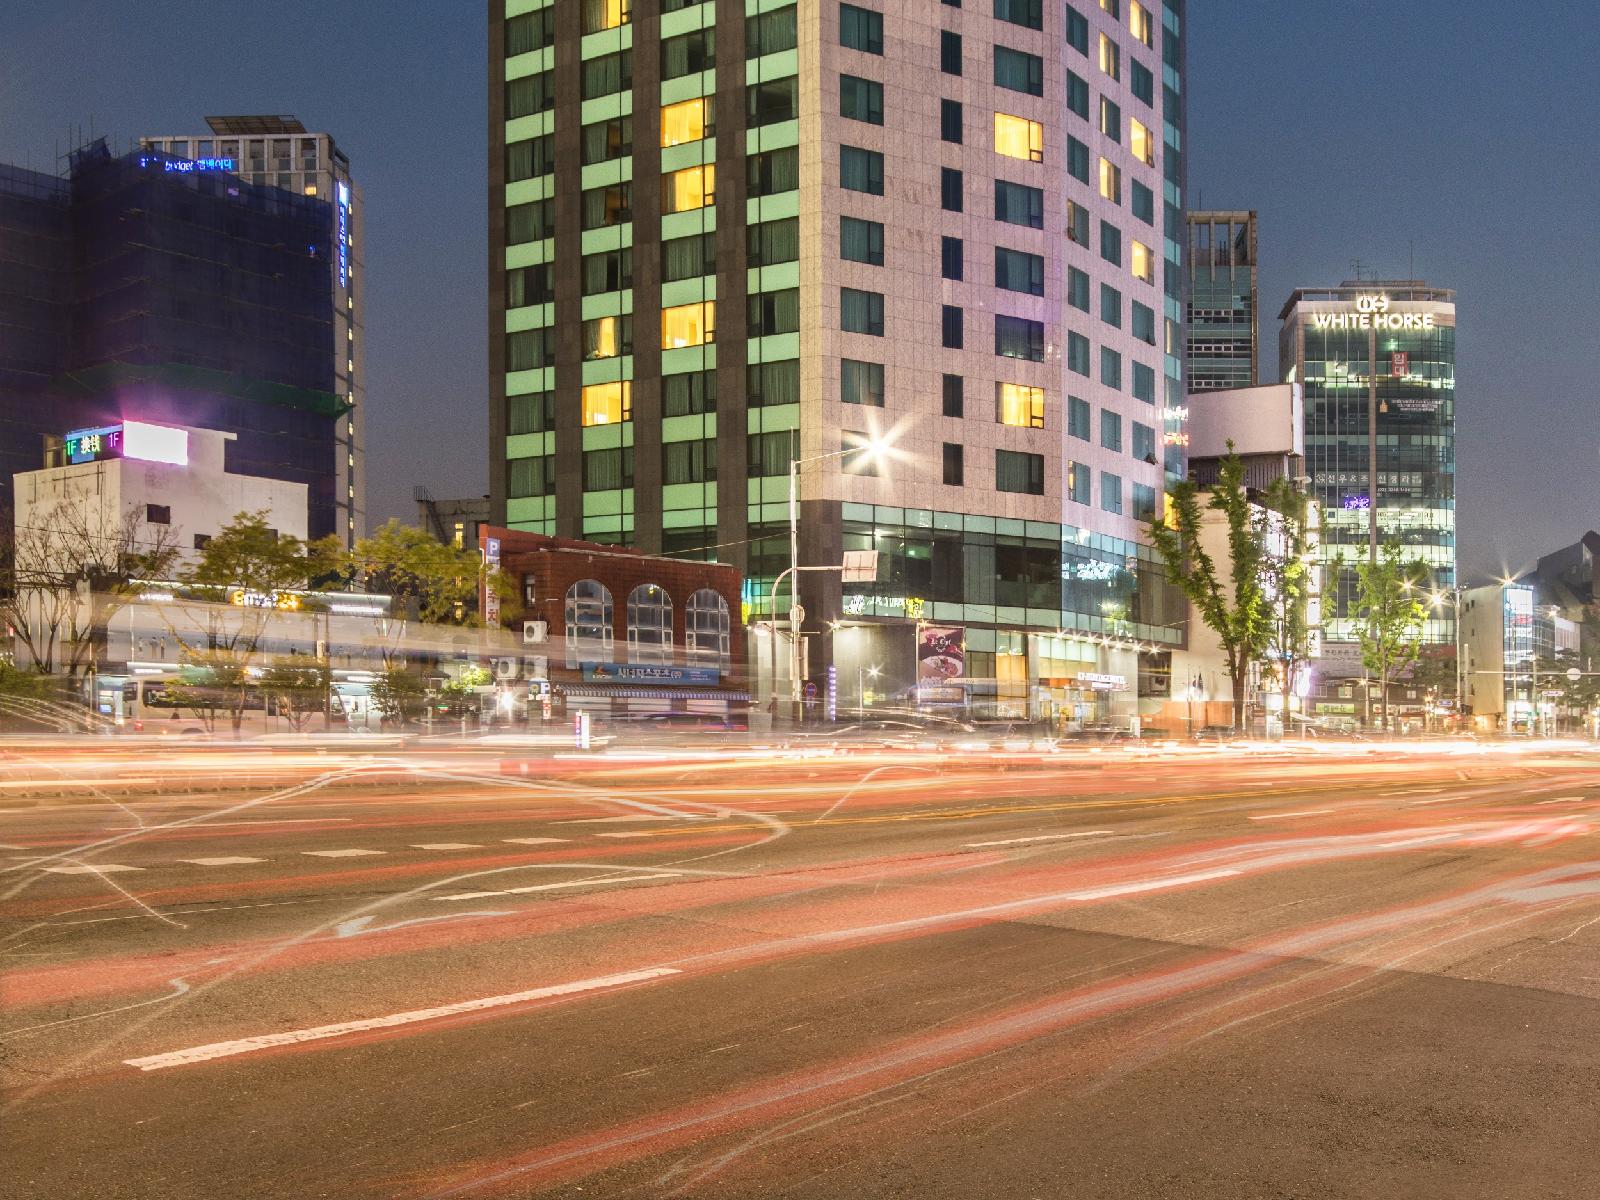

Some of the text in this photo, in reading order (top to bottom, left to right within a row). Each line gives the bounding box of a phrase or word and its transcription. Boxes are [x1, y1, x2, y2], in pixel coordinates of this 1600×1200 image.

[1313, 313, 1435, 329] WHITE HORSE
[66, 440, 77, 455] 1F
[108, 432, 120, 448] 1F
[489, 541, 498, 554] P
